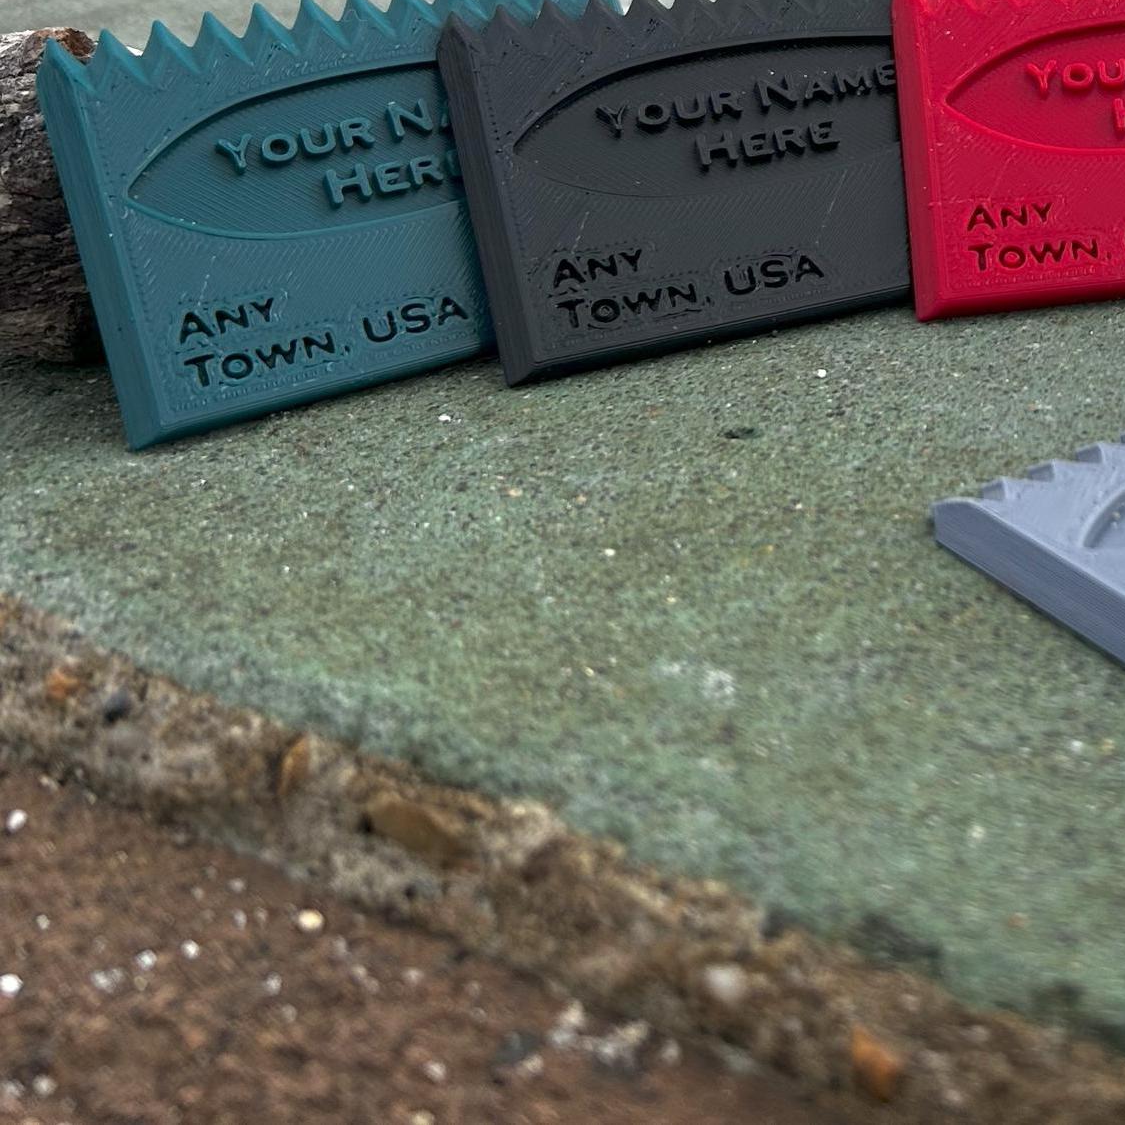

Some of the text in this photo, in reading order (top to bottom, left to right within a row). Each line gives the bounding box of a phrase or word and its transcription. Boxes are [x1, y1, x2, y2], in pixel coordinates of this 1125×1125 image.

[322, 148, 462, 210] HER
[722, 254, 826, 296] USA
[361, 296, 469, 344] USA
